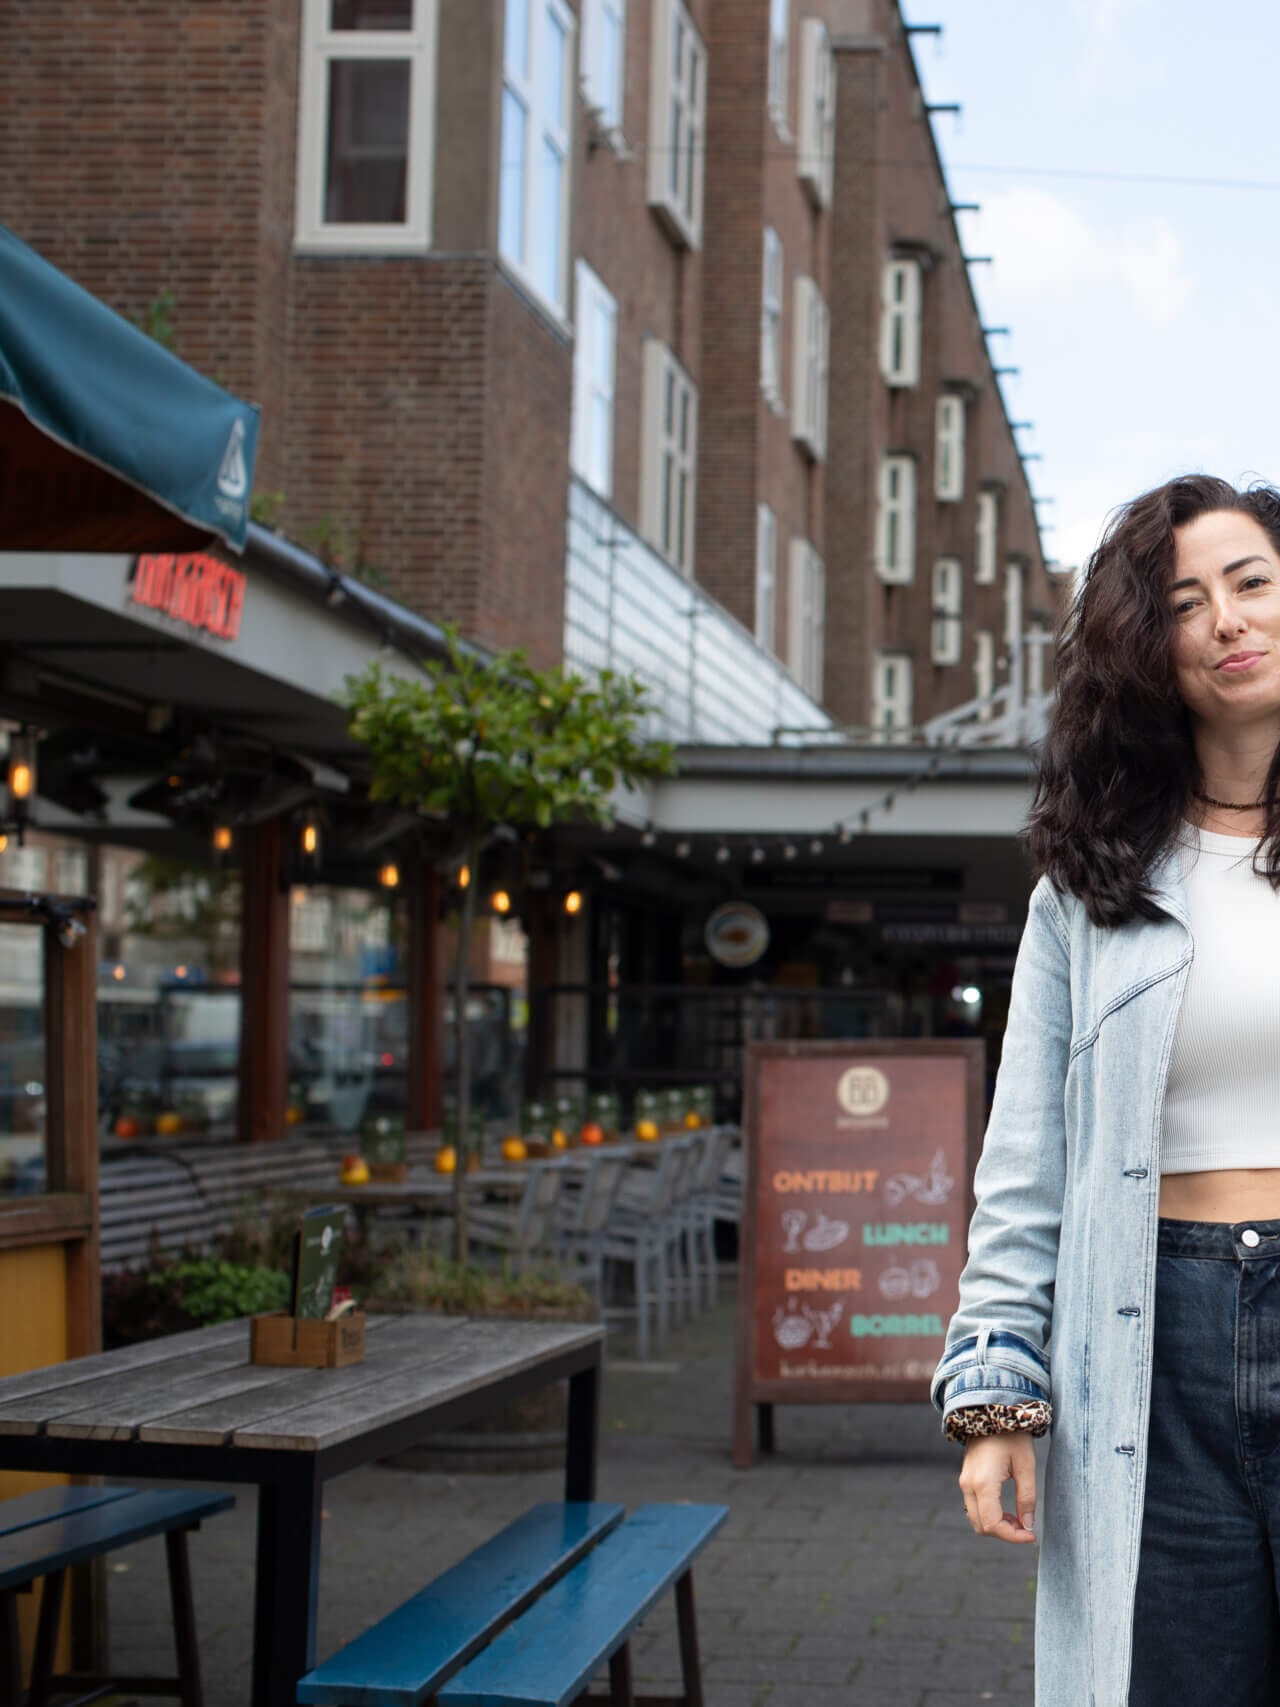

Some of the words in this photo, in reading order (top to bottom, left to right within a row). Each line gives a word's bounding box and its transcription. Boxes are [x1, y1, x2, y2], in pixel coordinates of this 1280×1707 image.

[863, 1224, 948, 1245] LUNCH
[785, 1269, 861, 1291] DINER
[851, 1315, 943, 1337] BORREL
